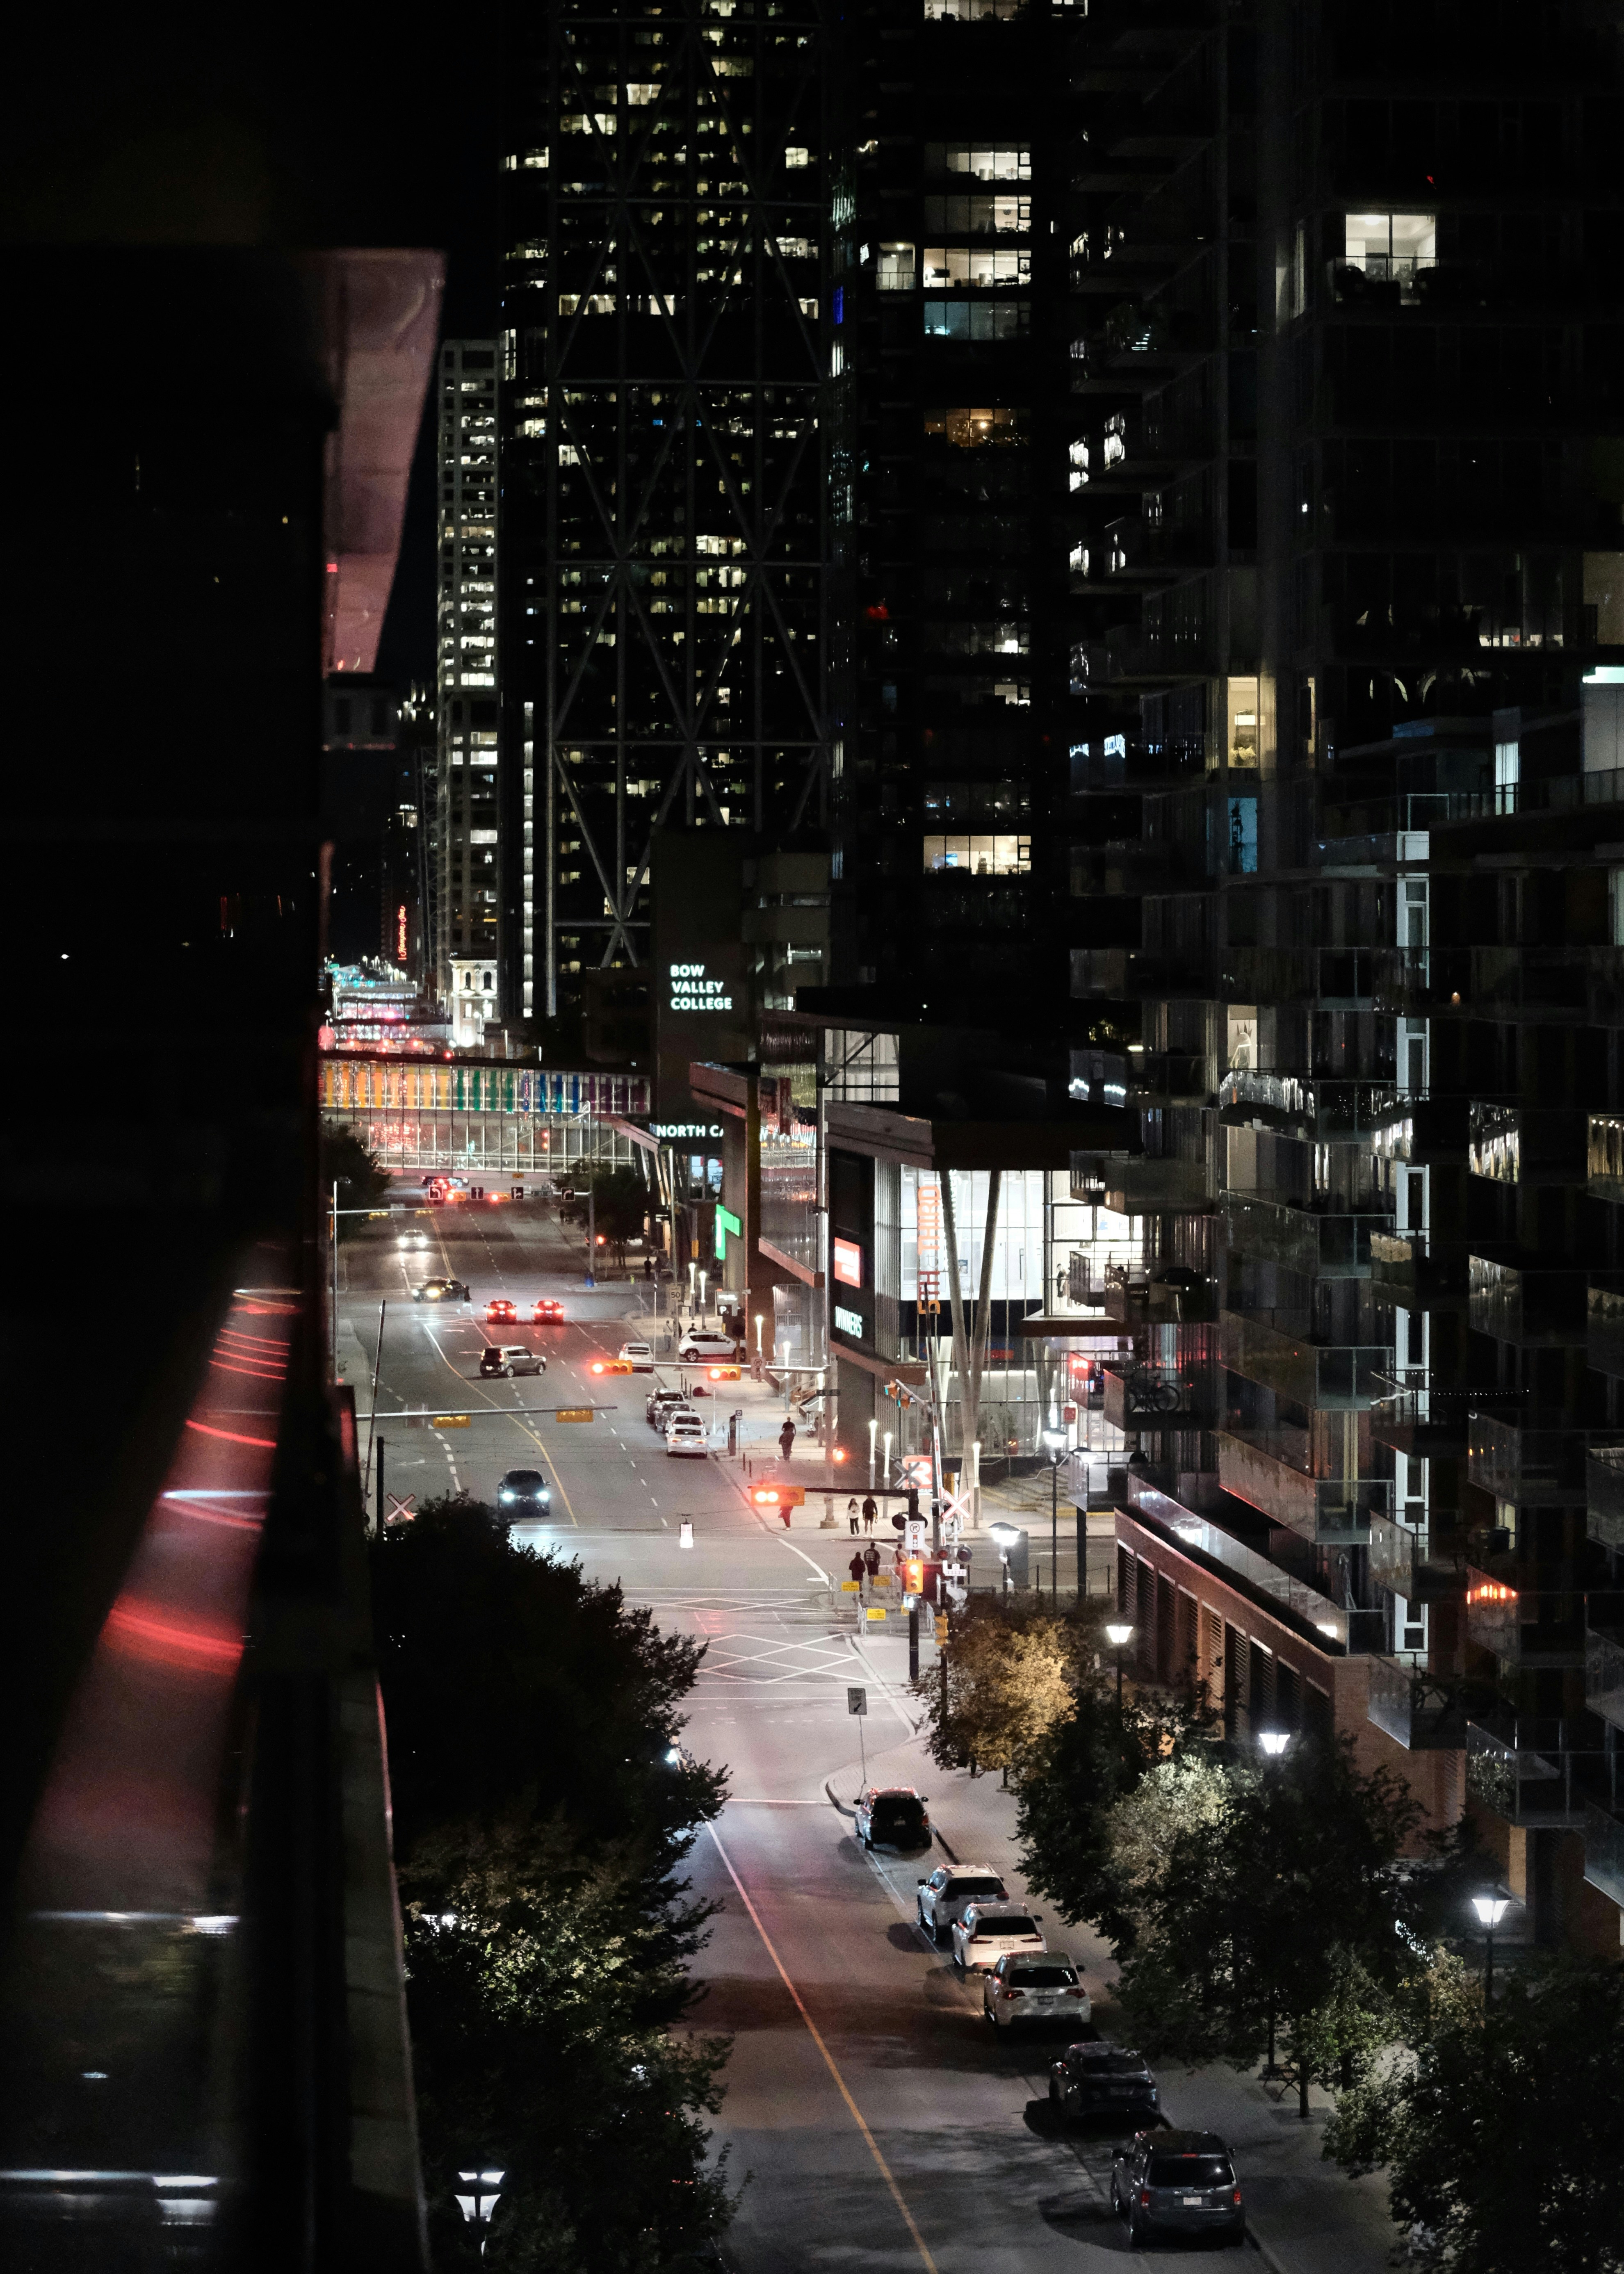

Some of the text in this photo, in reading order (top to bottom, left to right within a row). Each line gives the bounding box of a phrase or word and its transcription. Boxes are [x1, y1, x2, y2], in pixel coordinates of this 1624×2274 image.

[398, 923, 406, 957] Hampton
[670, 965, 705, 977] BOW
[672, 981, 724, 993] VALLEY
[671, 997, 732, 1010] COLLEGE
[657, 1125, 705, 1137] NORTH
[918, 1186, 941, 1255] THIRD
[720, 1306, 727, 1314] P
[835, 1306, 862, 1339] WINNERS
